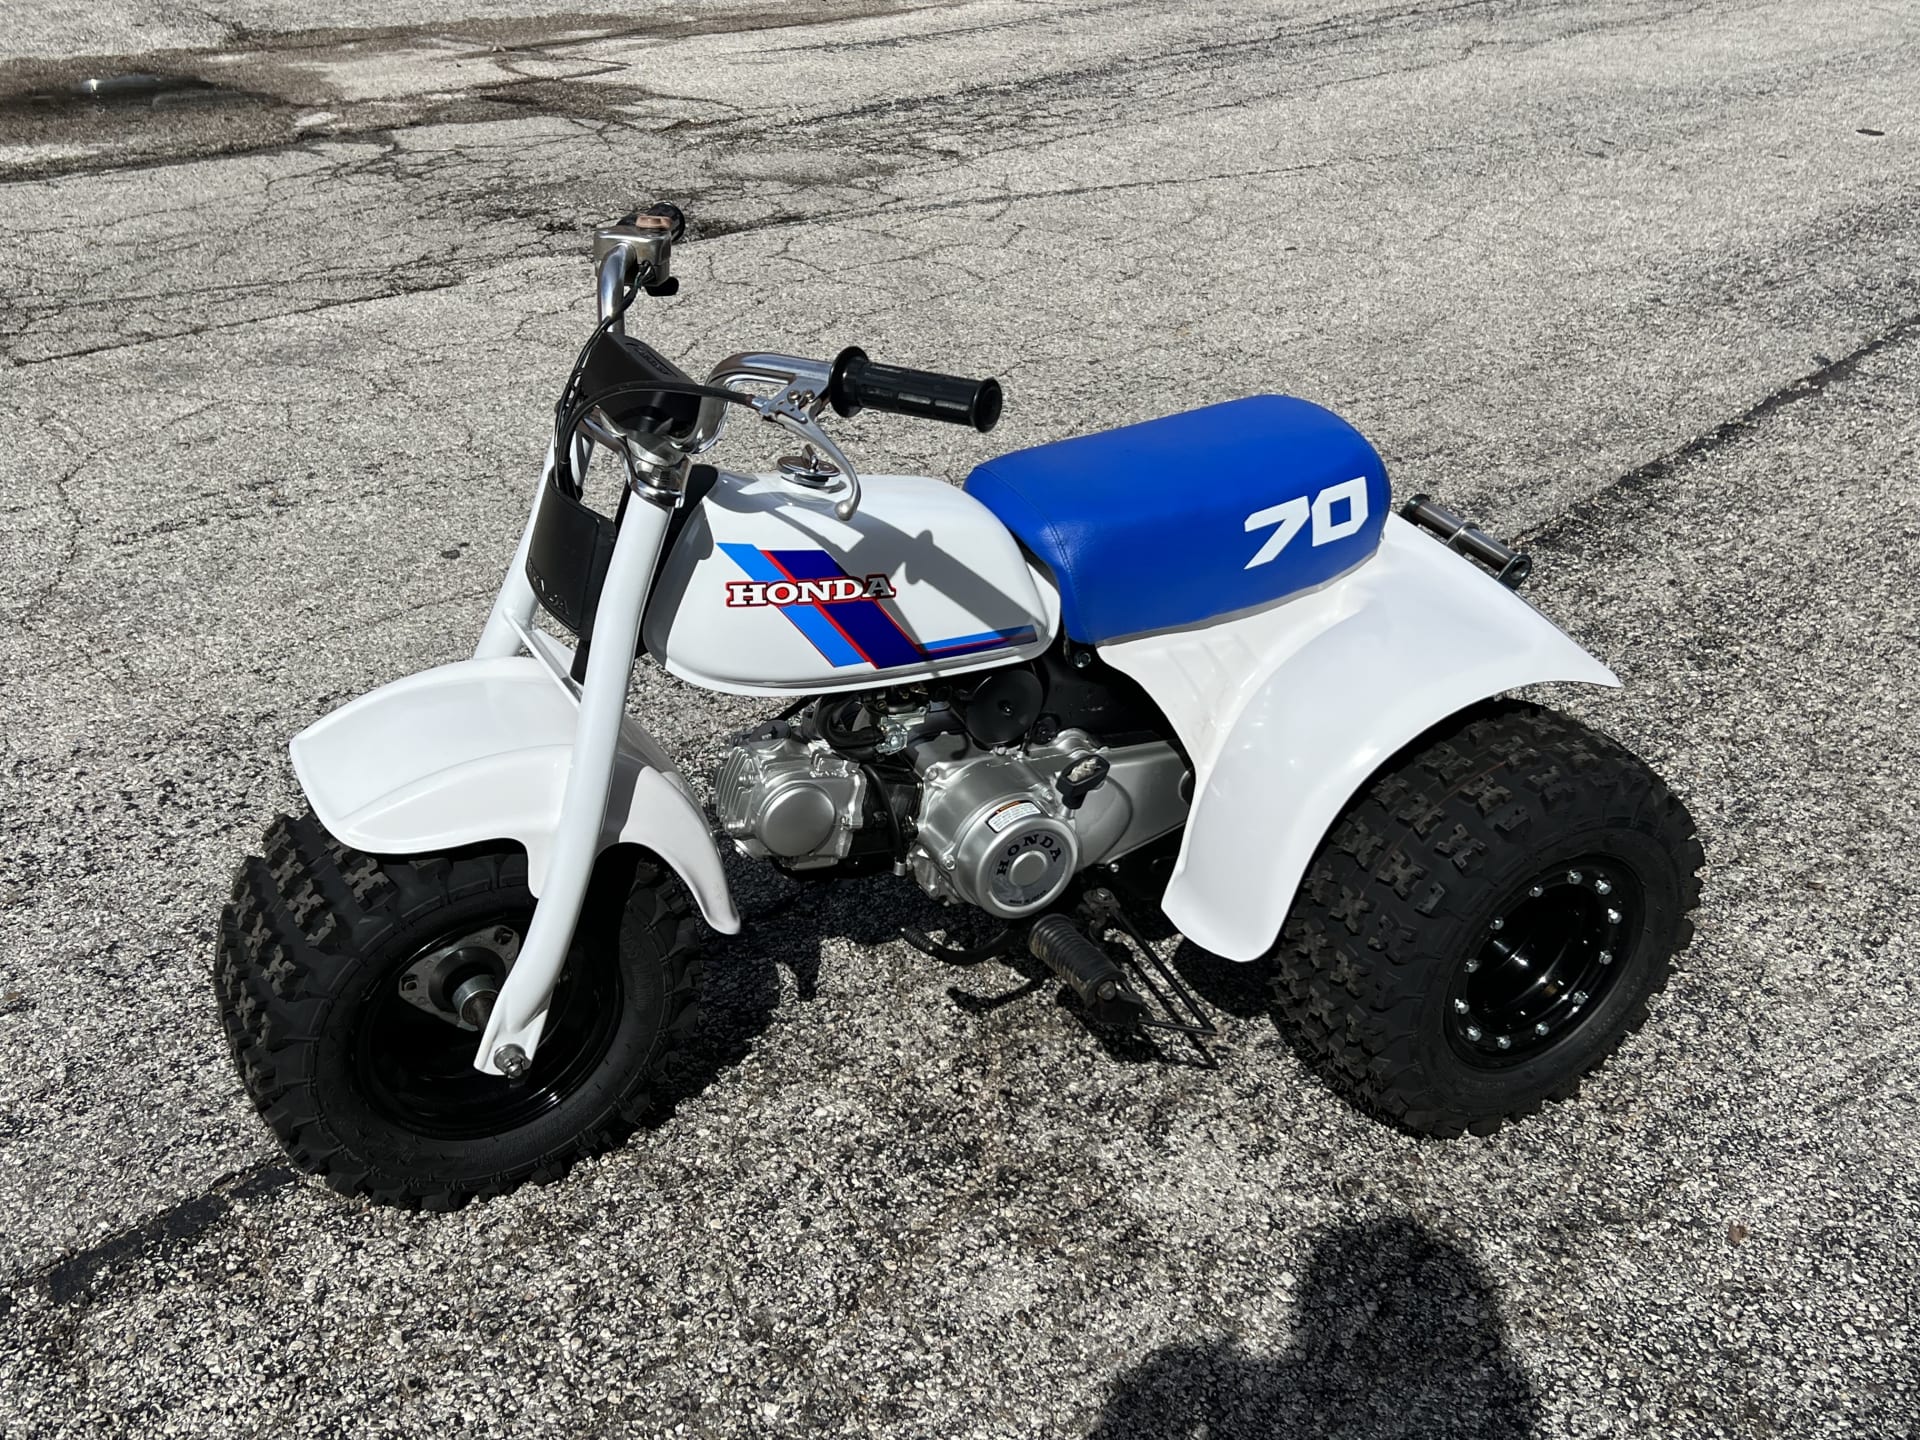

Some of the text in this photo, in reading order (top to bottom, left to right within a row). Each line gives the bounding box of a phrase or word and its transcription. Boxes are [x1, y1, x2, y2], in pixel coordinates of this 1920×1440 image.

[1244, 476, 1369, 570] 70
[727, 575, 896, 606] HONDA
[996, 833, 1062, 876] HONDA
